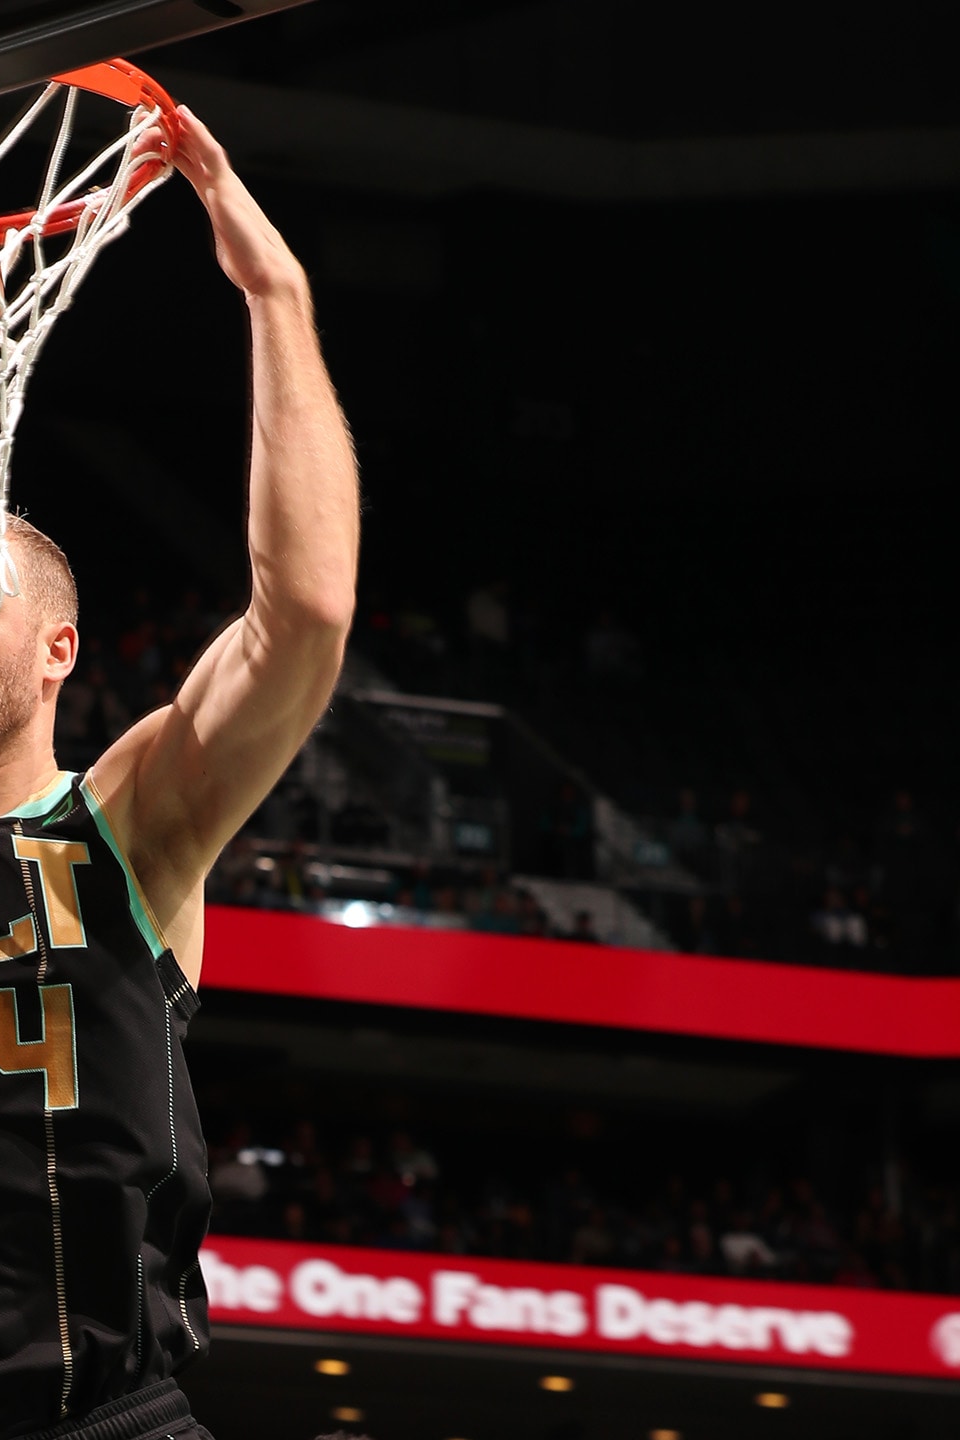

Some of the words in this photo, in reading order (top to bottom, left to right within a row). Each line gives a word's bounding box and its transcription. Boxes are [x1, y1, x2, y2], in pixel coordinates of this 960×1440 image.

[198, 1249, 283, 1313] he
[291, 1258, 423, 1324] One
[431, 1270, 589, 1337] Fans
[595, 1283, 854, 1357] Deserve
